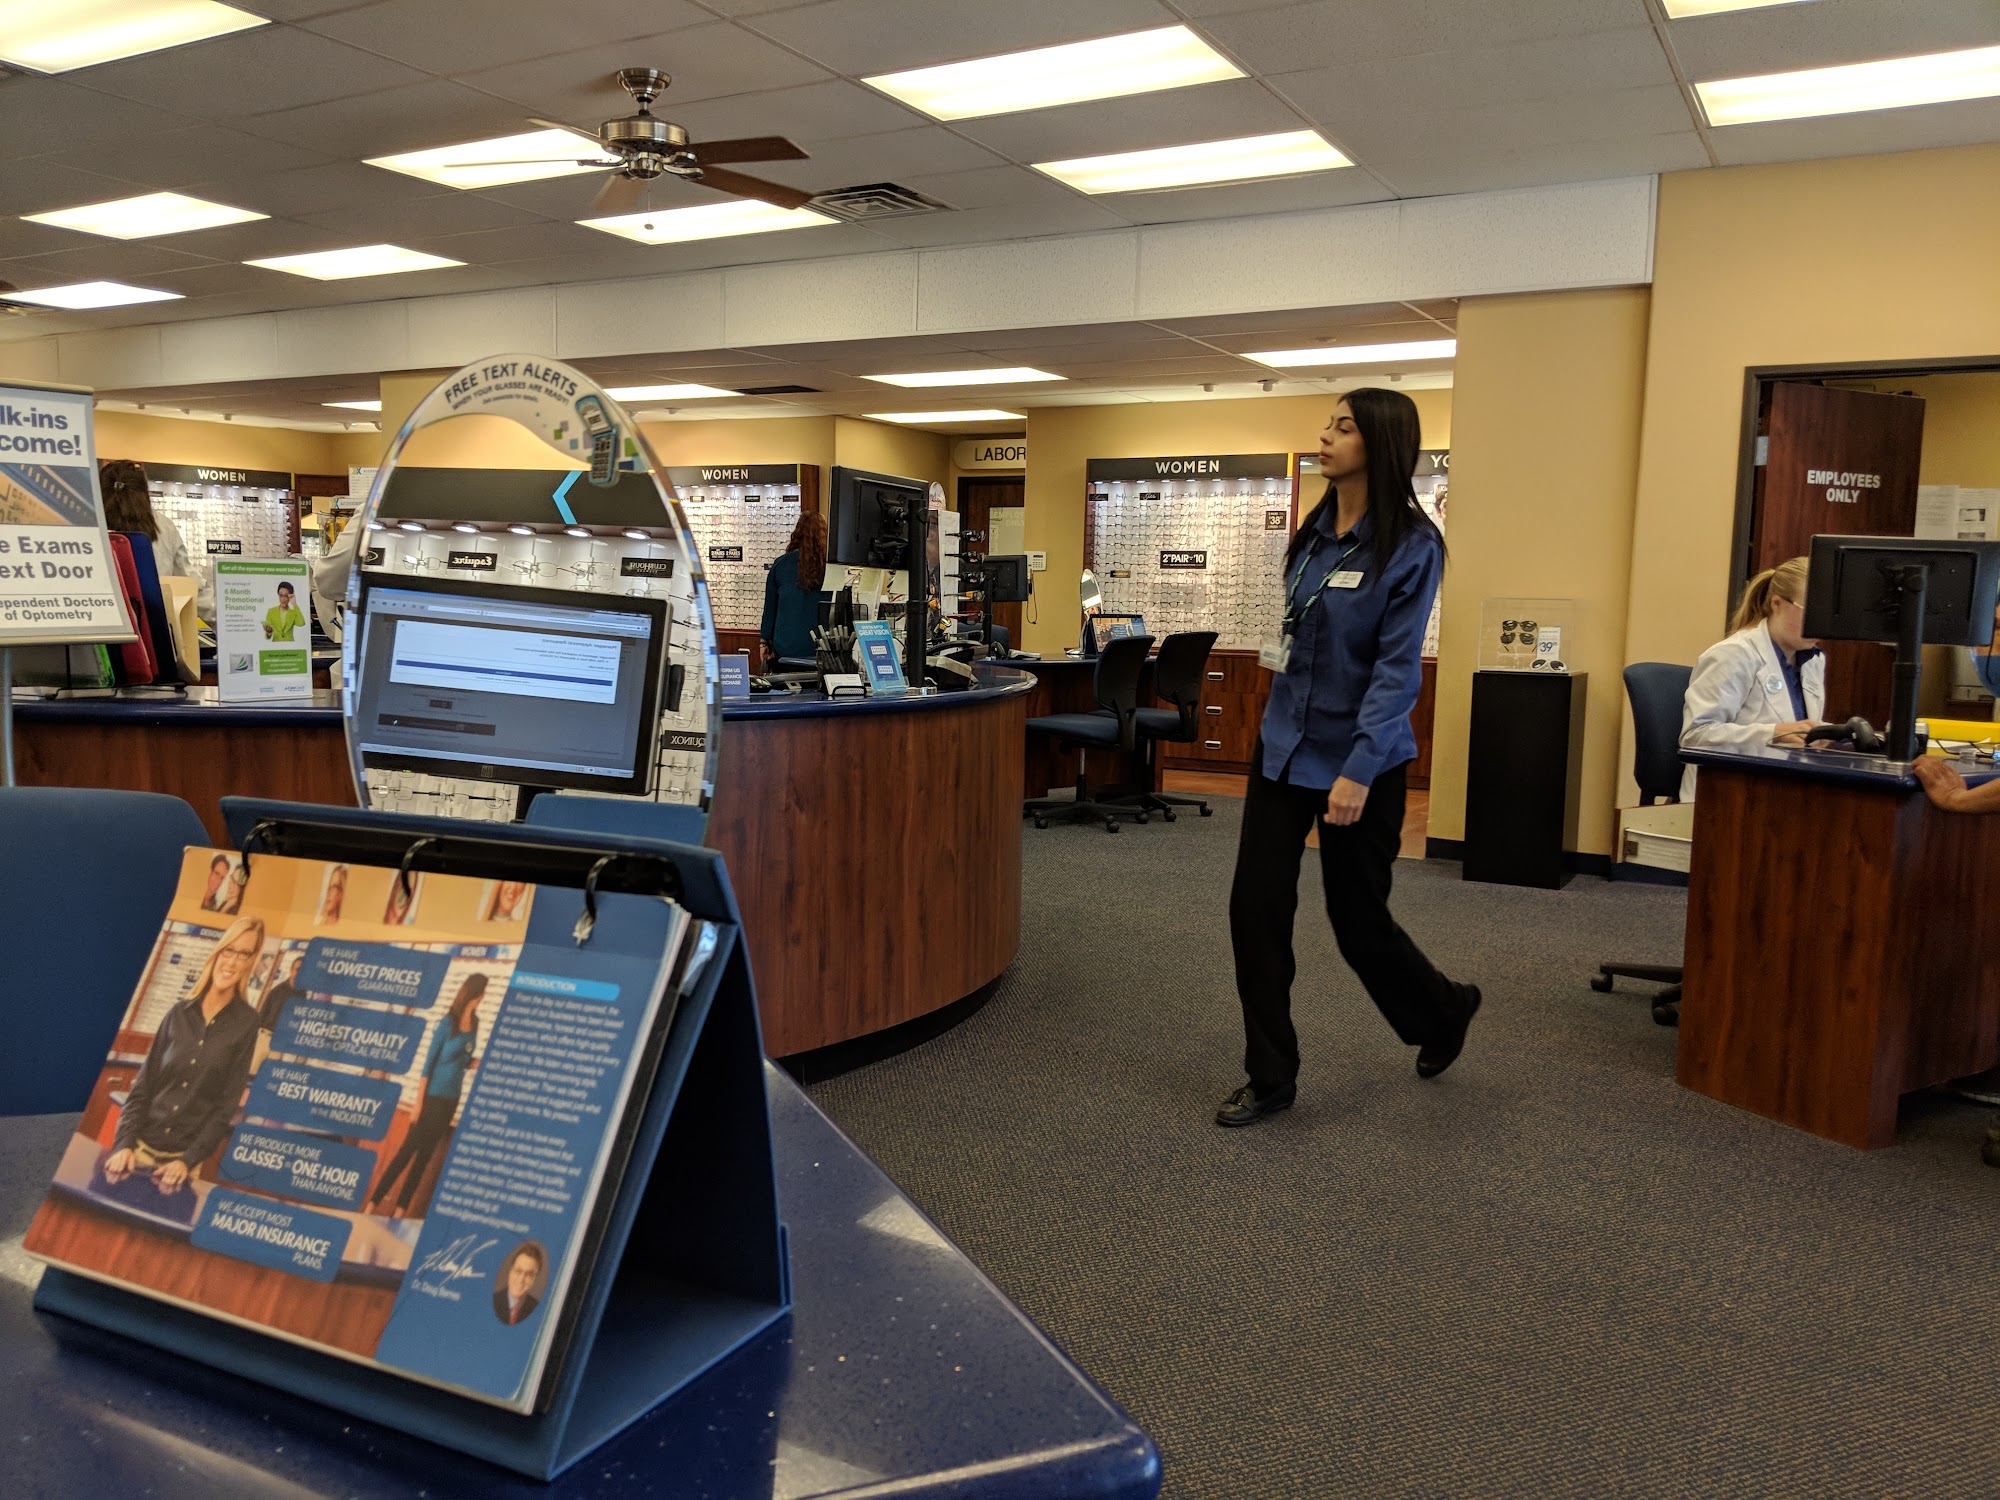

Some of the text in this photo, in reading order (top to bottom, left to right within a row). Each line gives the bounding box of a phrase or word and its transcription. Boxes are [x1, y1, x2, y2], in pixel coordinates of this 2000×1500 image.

[445, 363, 578, 403] FREE TEXT ALERTS
[473, 386, 493, 399] YOUR
[495, 382, 526, 392] GLASSES
[529, 382, 543, 392] ARE
[0, 434, 82, 456] come!
[975, 447, 1026, 461] LABOR
[702, 469, 749, 480] WOMEN
[1155, 460, 1220, 474] WOMEN
[197, 469, 246, 482] WOMEN
[1807, 469, 1881, 488] EMPLOYEES
[1826, 488, 1860, 503] ONLY
[18, 536, 93, 554] Exams
[1171, 554, 1189, 563] PAIR
[41, 561, 93, 578] Door
[63, 597, 114, 607] Doctors
[225, 604, 257, 612] Financing
[5, 610, 93, 622] of Optometry
[321, 947, 360, 961] WE HAVE
[327, 960, 379, 979] LOWEST
[378, 967, 422, 986] PRICES
[515, 976, 577, 991] INTRODUCTION
[293, 1006, 337, 1021] WE OFFER
[298, 1020, 352, 1041] HIGHEST
[351, 1027, 409, 1050] QUALITY
[294, 1035, 326, 1048] LENSES
[332, 1041, 369, 1057] OPTICAL
[271, 1067, 311, 1083] WE HAVE
[277, 1082, 309, 1100] BEST
[308, 1087, 382, 1115] WARRANTY
[239, 1133, 322, 1160] WE PRODUCE MORE
[233, 1146, 285, 1170] GLASSES
[291, 1159, 322, 1179] ONE
[319, 1166, 360, 1189] HOUR
[291, 1176, 316, 1191] THAN
[218, 1200, 294, 1227] WE ACCEPT MOST
[211, 1213, 331, 1258] MAJOR INSURANCE
